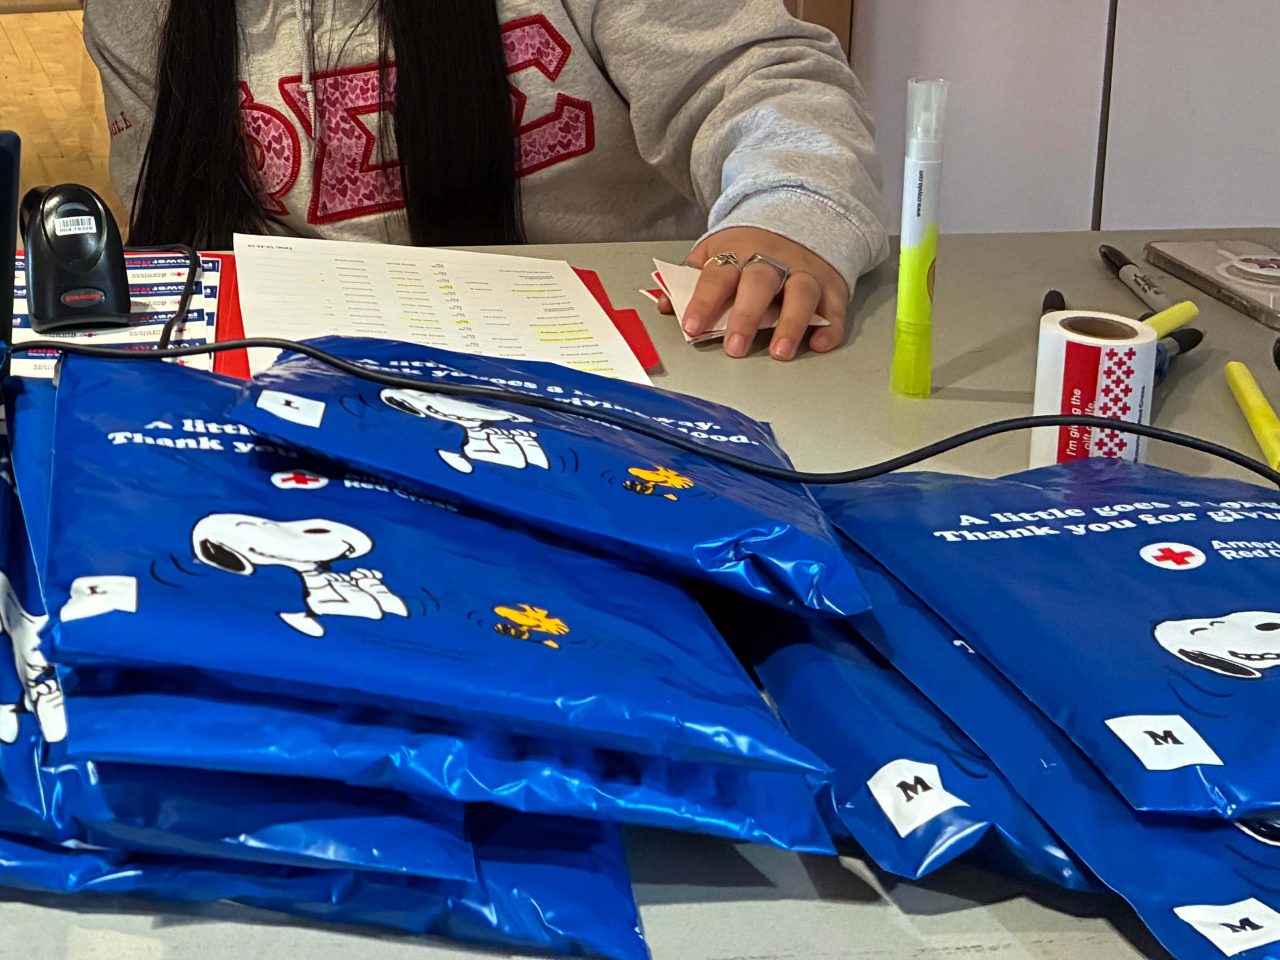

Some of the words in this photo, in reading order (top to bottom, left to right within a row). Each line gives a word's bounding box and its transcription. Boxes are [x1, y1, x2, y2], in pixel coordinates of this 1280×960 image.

[1070, 388, 1082, 406] the
[107, 431, 225, 452] Thank
[1066, 440, 1077, 456] I'm
[958, 514, 990, 527] A
[989, 507, 1086, 525] little
[1092, 501, 1171, 518] goes
[1176, 500, 1202, 508] a
[932, 524, 1061, 542] Thank
[1064, 518, 1138, 536] you
[1137, 509, 1197, 526] for
[1218, 549, 1271, 561] Red
[1141, 730, 1185, 746] M
[895, 775, 934, 803] M
[1218, 917, 1265, 933] M
